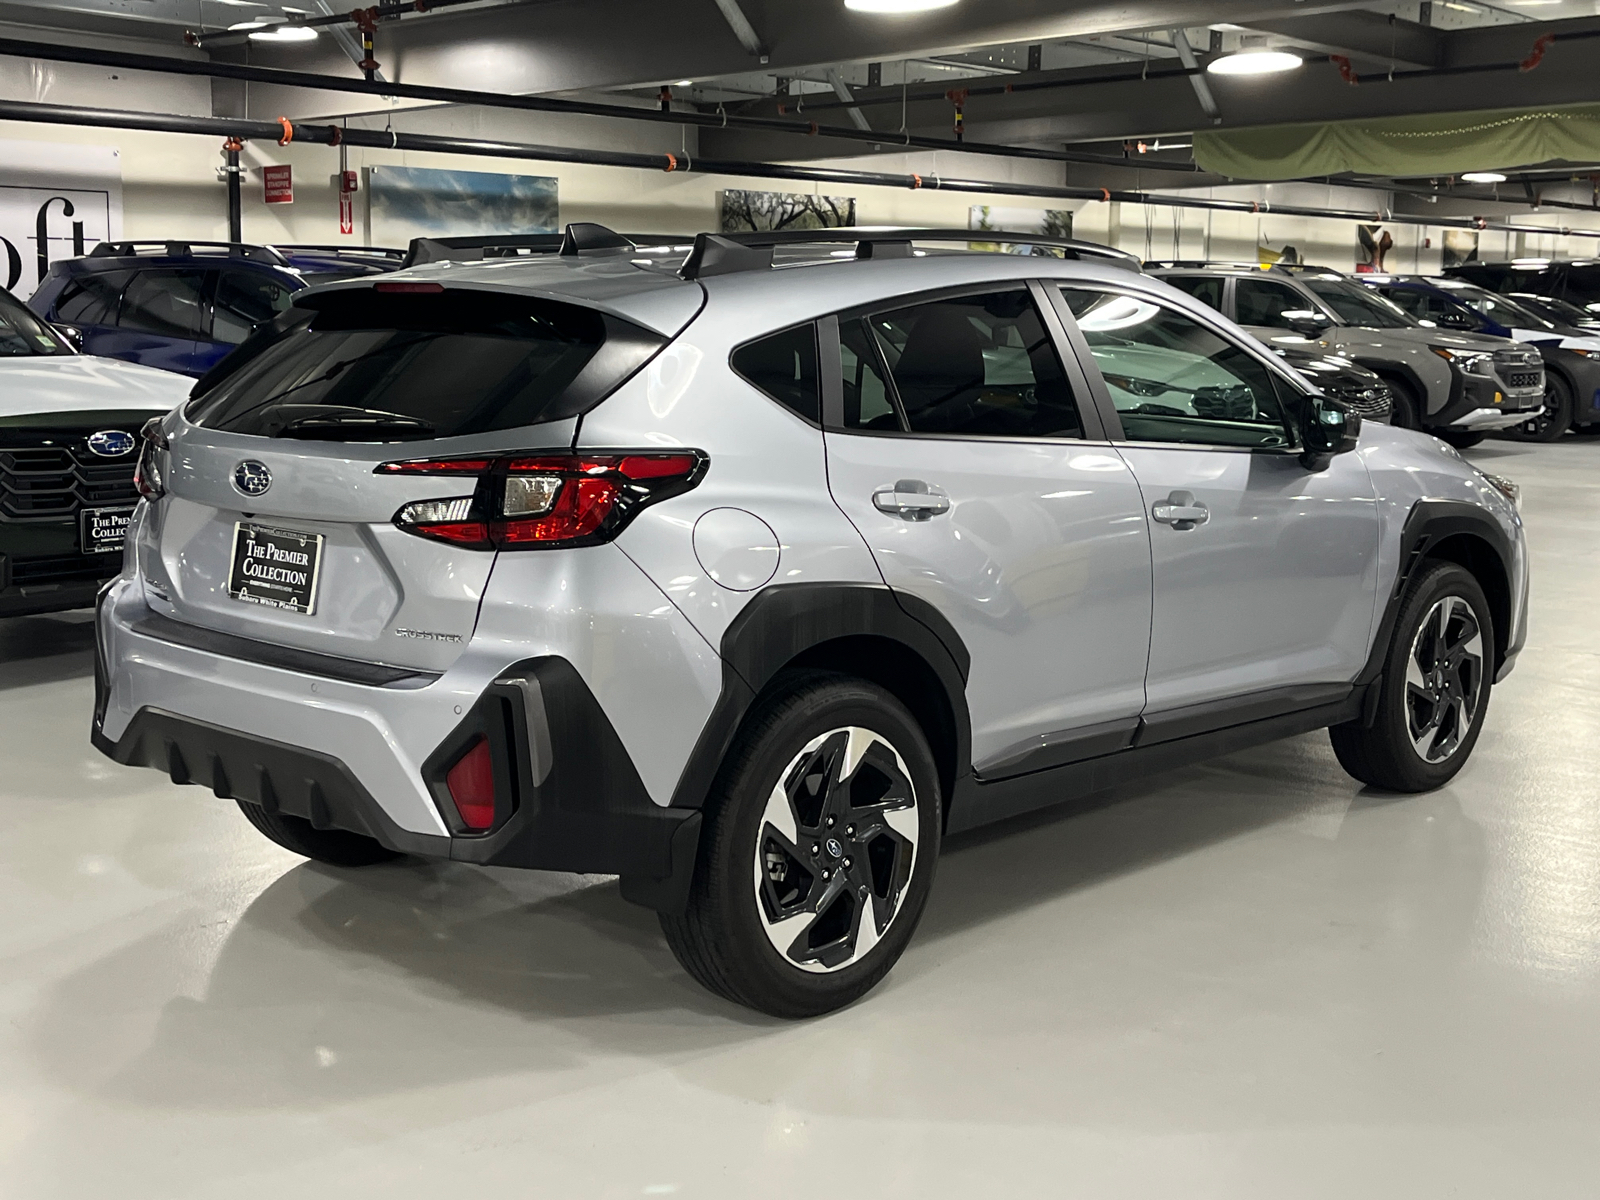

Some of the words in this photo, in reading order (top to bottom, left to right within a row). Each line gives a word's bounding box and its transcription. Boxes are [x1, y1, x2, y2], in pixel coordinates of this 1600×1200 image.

[91, 517, 110, 527] THE
[92, 527, 127, 538] COLLEC
[246, 539, 266, 559] THE
[265, 542, 309, 566] PREMIER
[242, 557, 307, 586] COLLECTION
[260, 599, 278, 607] White
[279, 602, 298, 611] Plains
[394, 627, 464, 643] CROSSTREK
